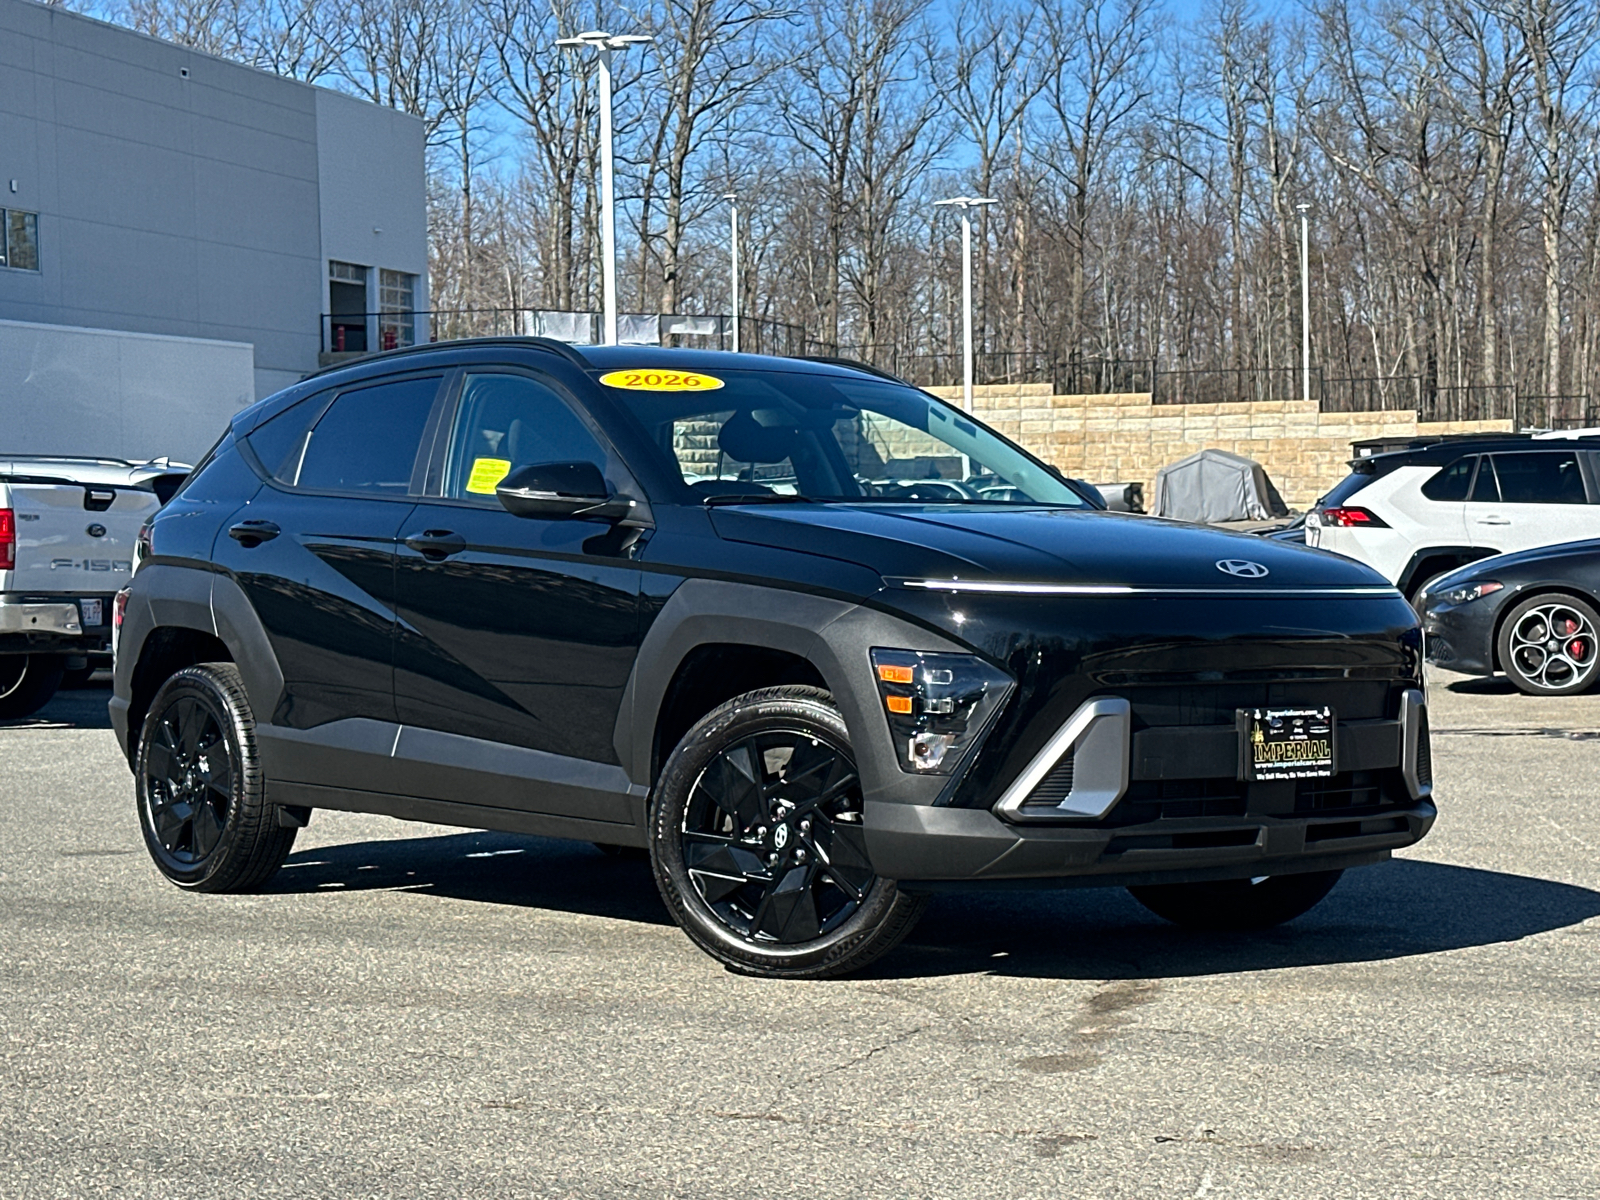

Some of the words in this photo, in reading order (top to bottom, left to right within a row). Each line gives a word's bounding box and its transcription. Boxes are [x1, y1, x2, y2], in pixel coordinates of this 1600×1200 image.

[624, 374, 701, 387] 2026
[50, 558, 132, 572] F-150
[1254, 740, 1331, 763] IMPERIAL
